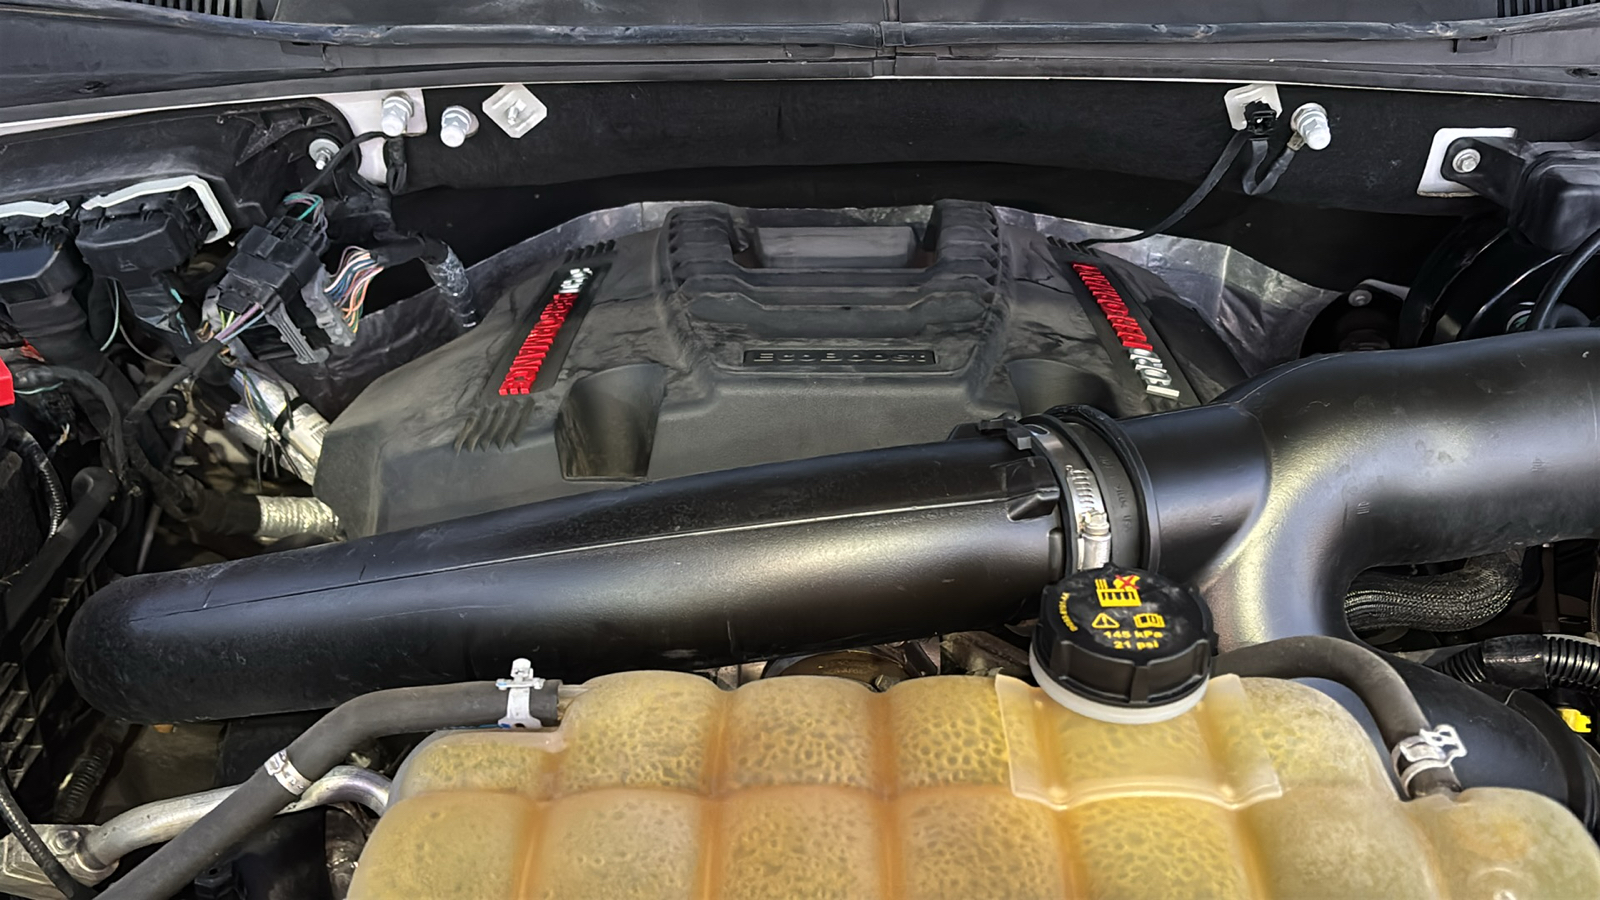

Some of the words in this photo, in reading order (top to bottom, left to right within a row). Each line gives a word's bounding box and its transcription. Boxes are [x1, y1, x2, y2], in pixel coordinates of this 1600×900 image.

[498, 292, 579, 396] PERFORMANCE
[753, 352, 926, 363] ECOBOOST
[1128, 347, 1180, 400] FORD
[1103, 630, 1132, 639] 145
[1134, 630, 1164, 639] kPa
[1113, 640, 1132, 650] 21
[1136, 640, 1160, 651] psi
